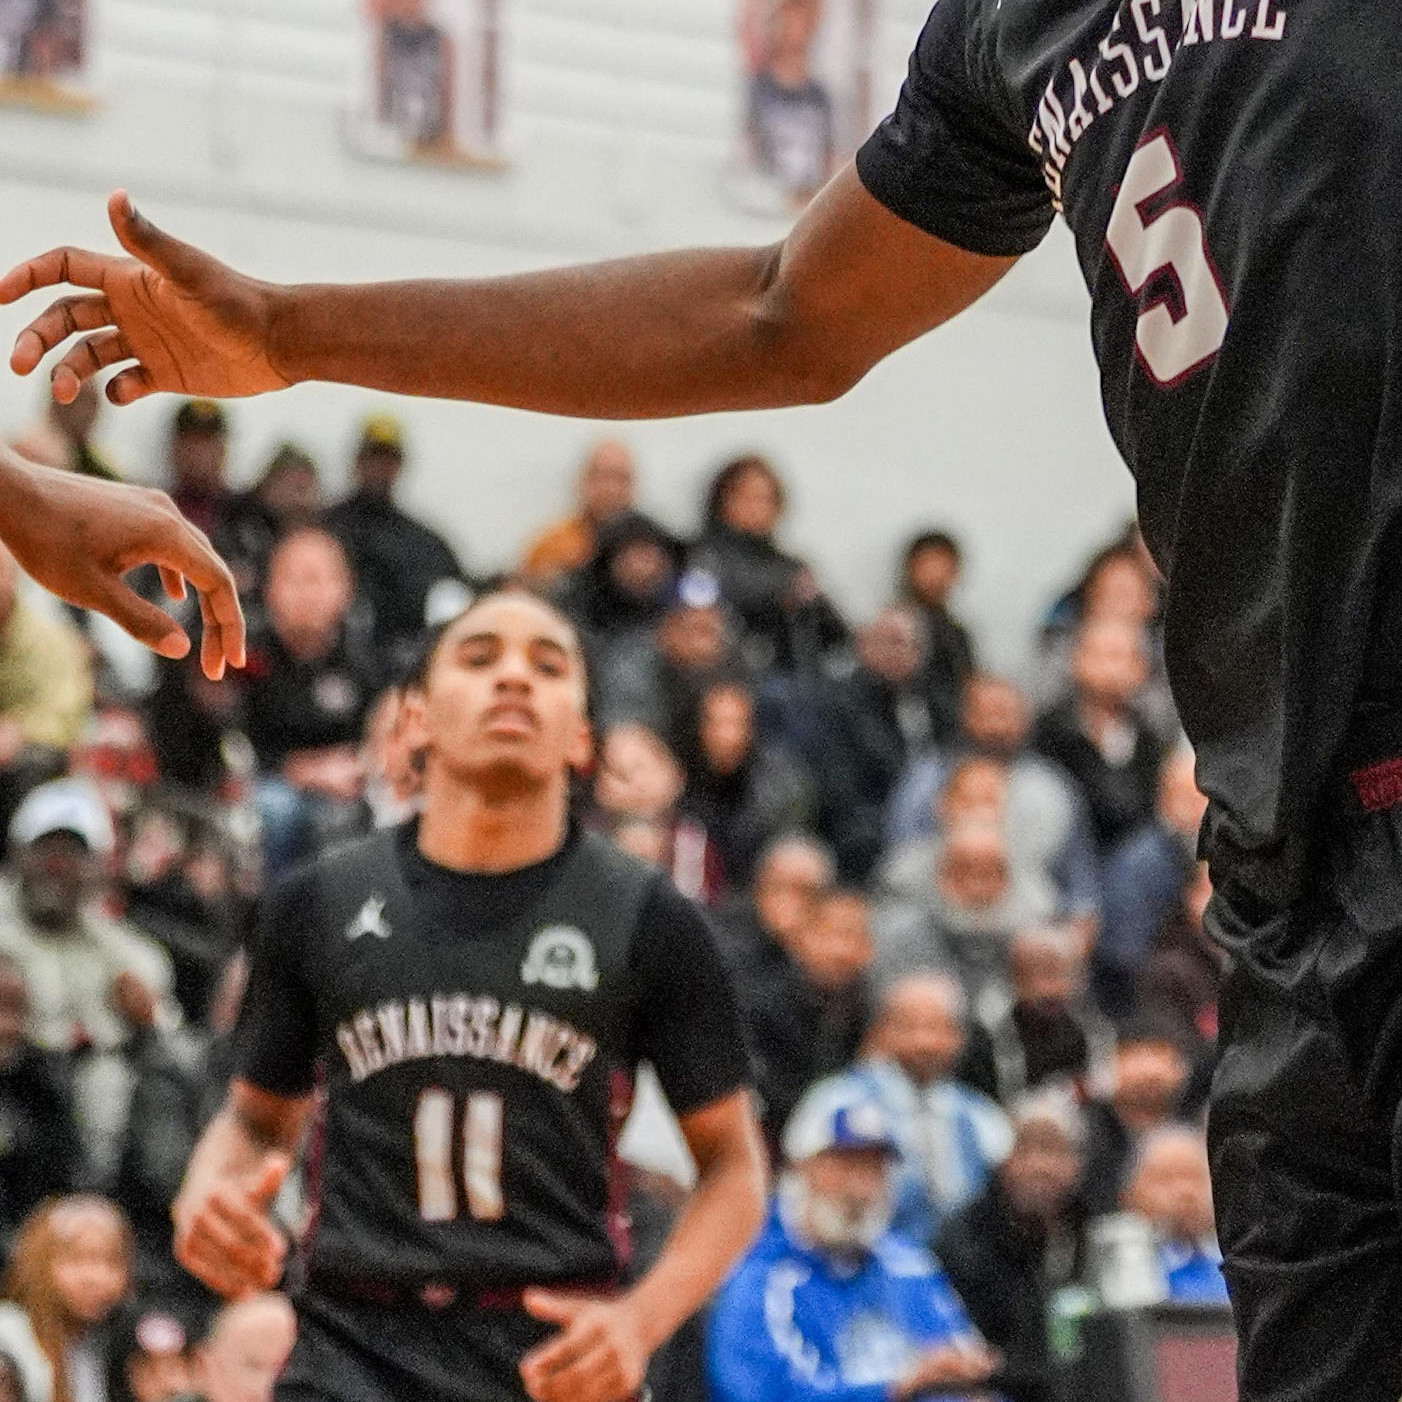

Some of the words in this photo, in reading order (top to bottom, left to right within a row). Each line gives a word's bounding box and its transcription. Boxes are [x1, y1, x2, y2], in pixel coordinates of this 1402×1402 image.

[1105, 125, 1230, 387] 5
[336, 994, 597, 1092] RENAISSANCE
[414, 1083, 506, 1223] 11
